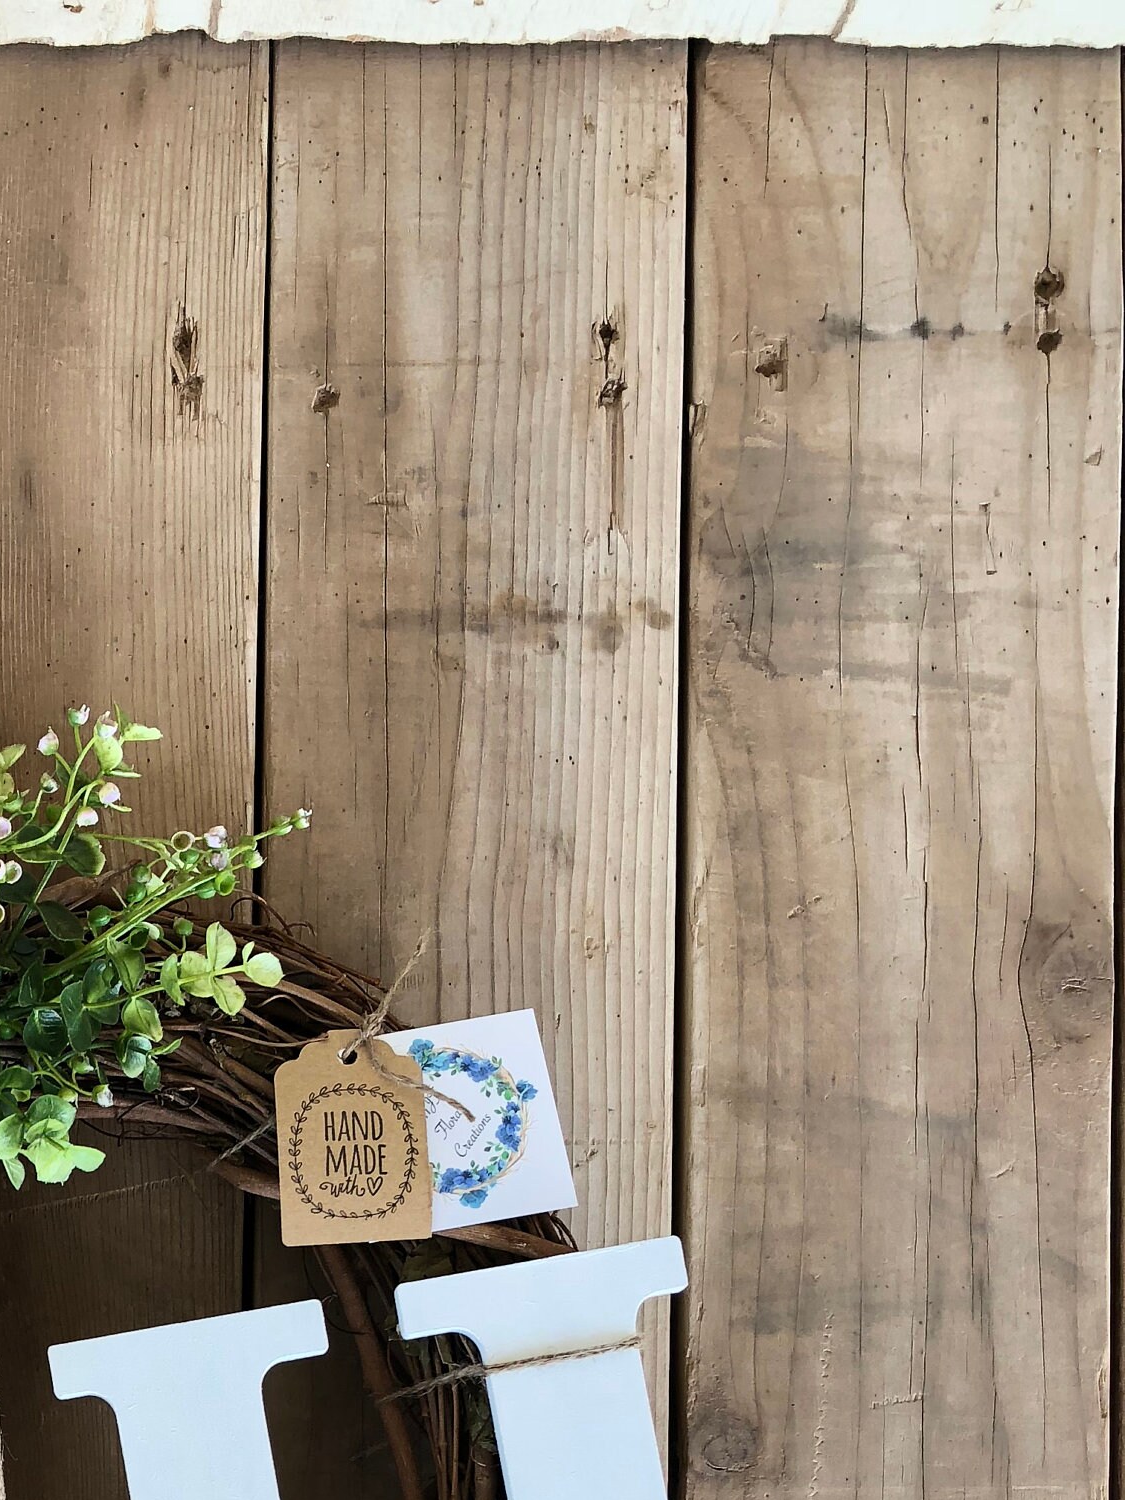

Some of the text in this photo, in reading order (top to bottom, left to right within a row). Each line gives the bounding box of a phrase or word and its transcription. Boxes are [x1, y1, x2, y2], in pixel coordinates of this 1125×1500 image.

[324, 1111, 383, 1141] HAND
[455, 1114, 491, 1157] Creations
[326, 1144, 388, 1177] MADE
[319, 1174, 365, 1197] with
